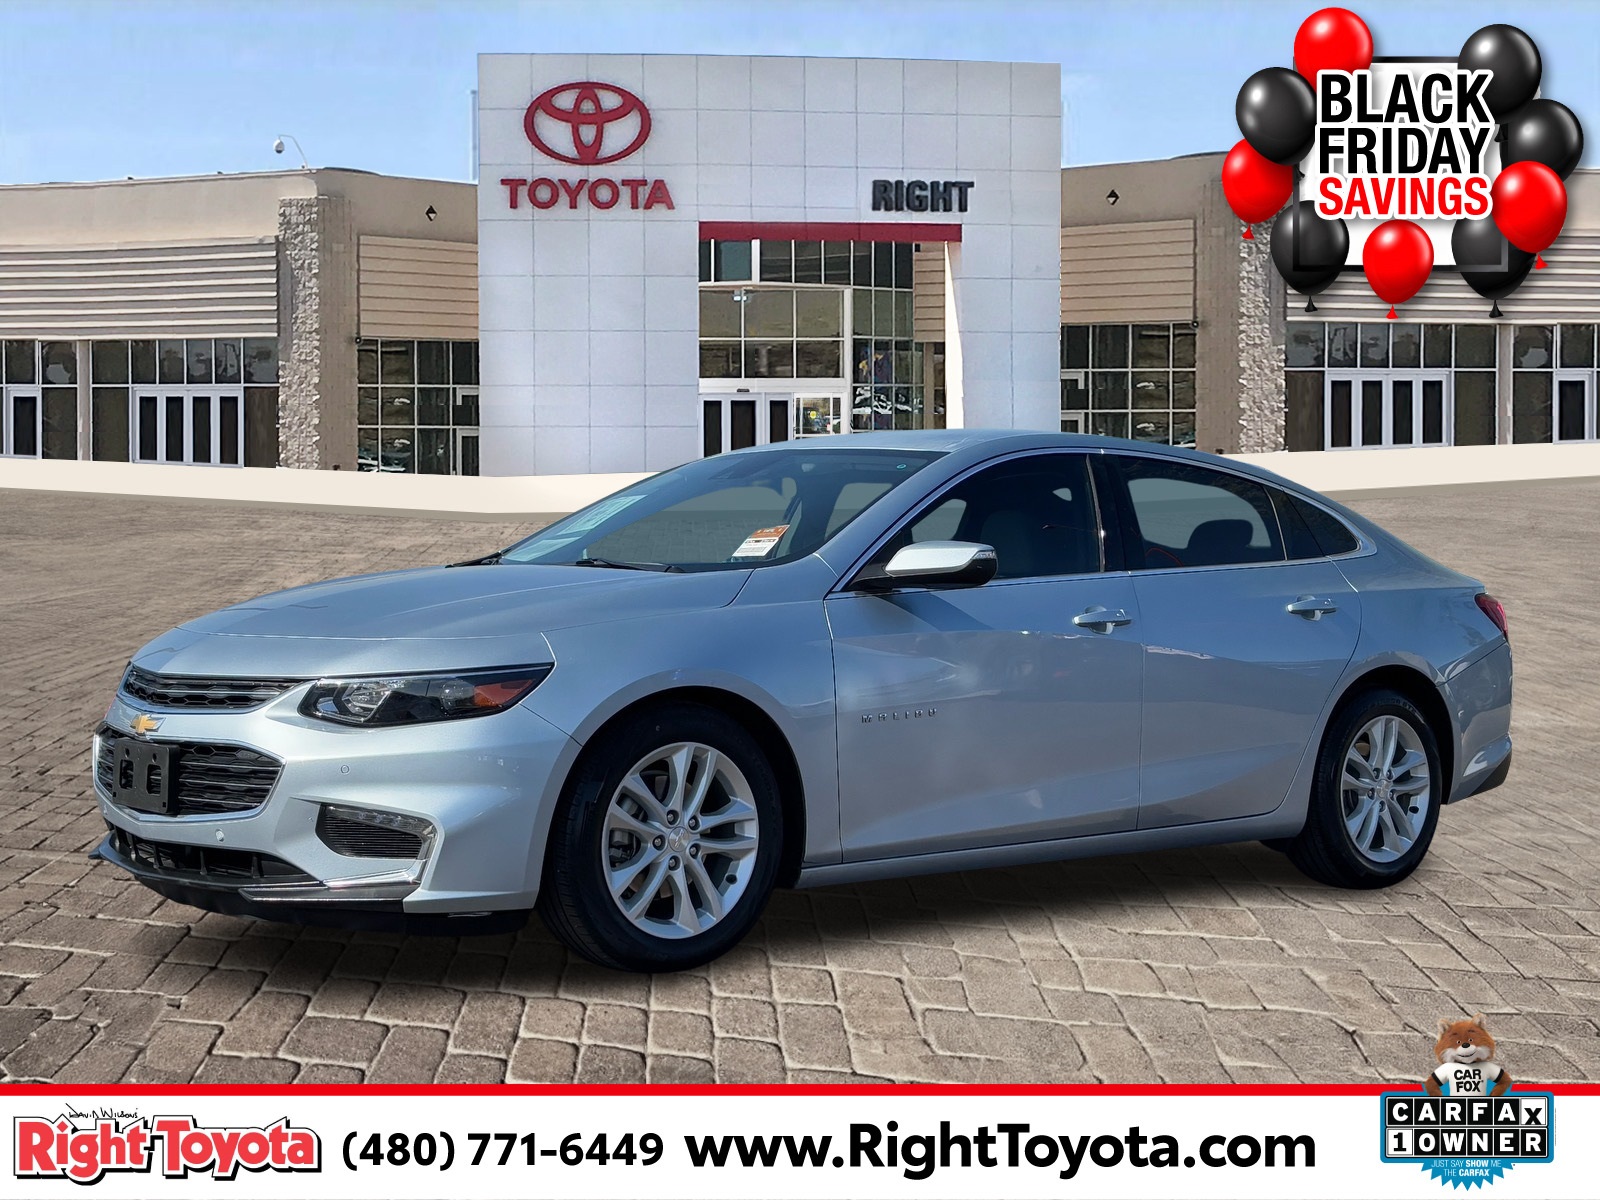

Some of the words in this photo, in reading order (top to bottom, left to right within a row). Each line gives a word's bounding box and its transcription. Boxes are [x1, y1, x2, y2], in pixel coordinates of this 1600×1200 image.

[500, 178, 675, 210] TOYOTA
[871, 179, 975, 213] RIGHT
[861, 707, 937, 723] MALIBU
